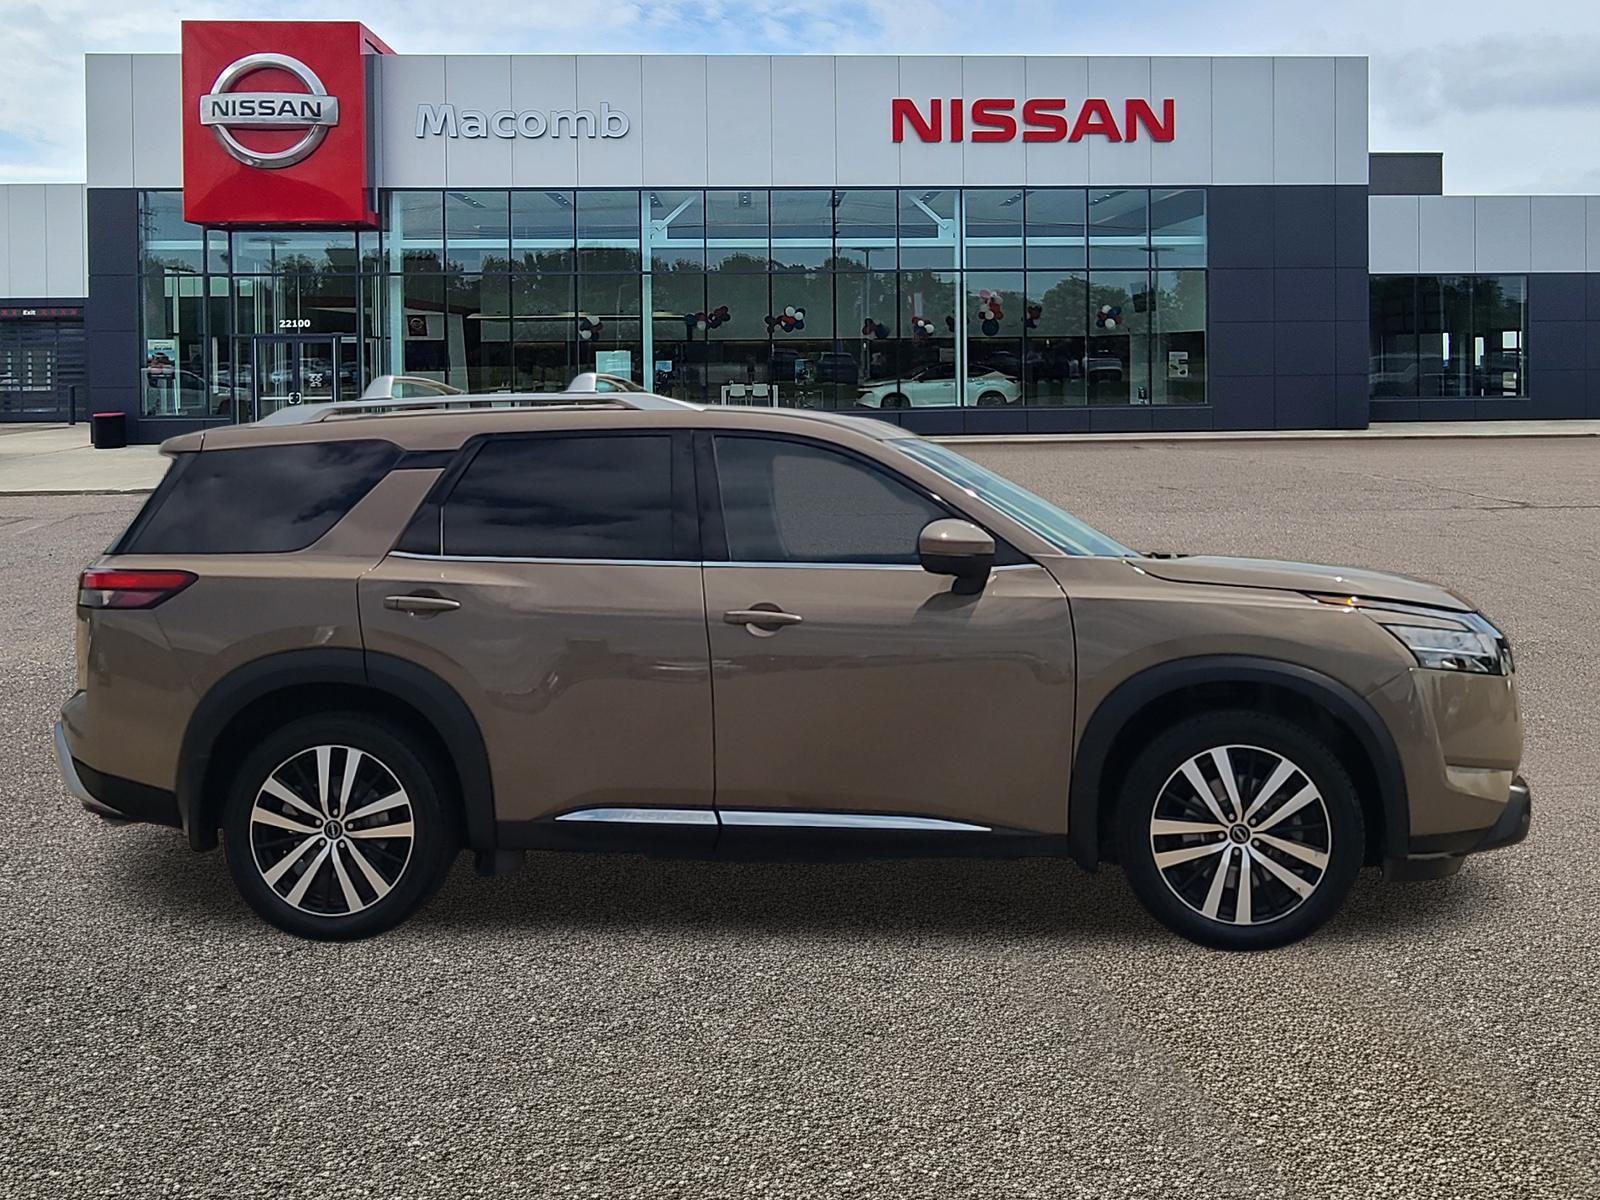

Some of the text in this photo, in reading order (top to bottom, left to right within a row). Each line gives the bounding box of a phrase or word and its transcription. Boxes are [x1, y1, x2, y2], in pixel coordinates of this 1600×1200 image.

[211, 100, 322, 118] NISSAN
[415, 102, 630, 139] Macomb
[892, 98, 1175, 143] NISSAN
[279, 319, 311, 328] 22100
